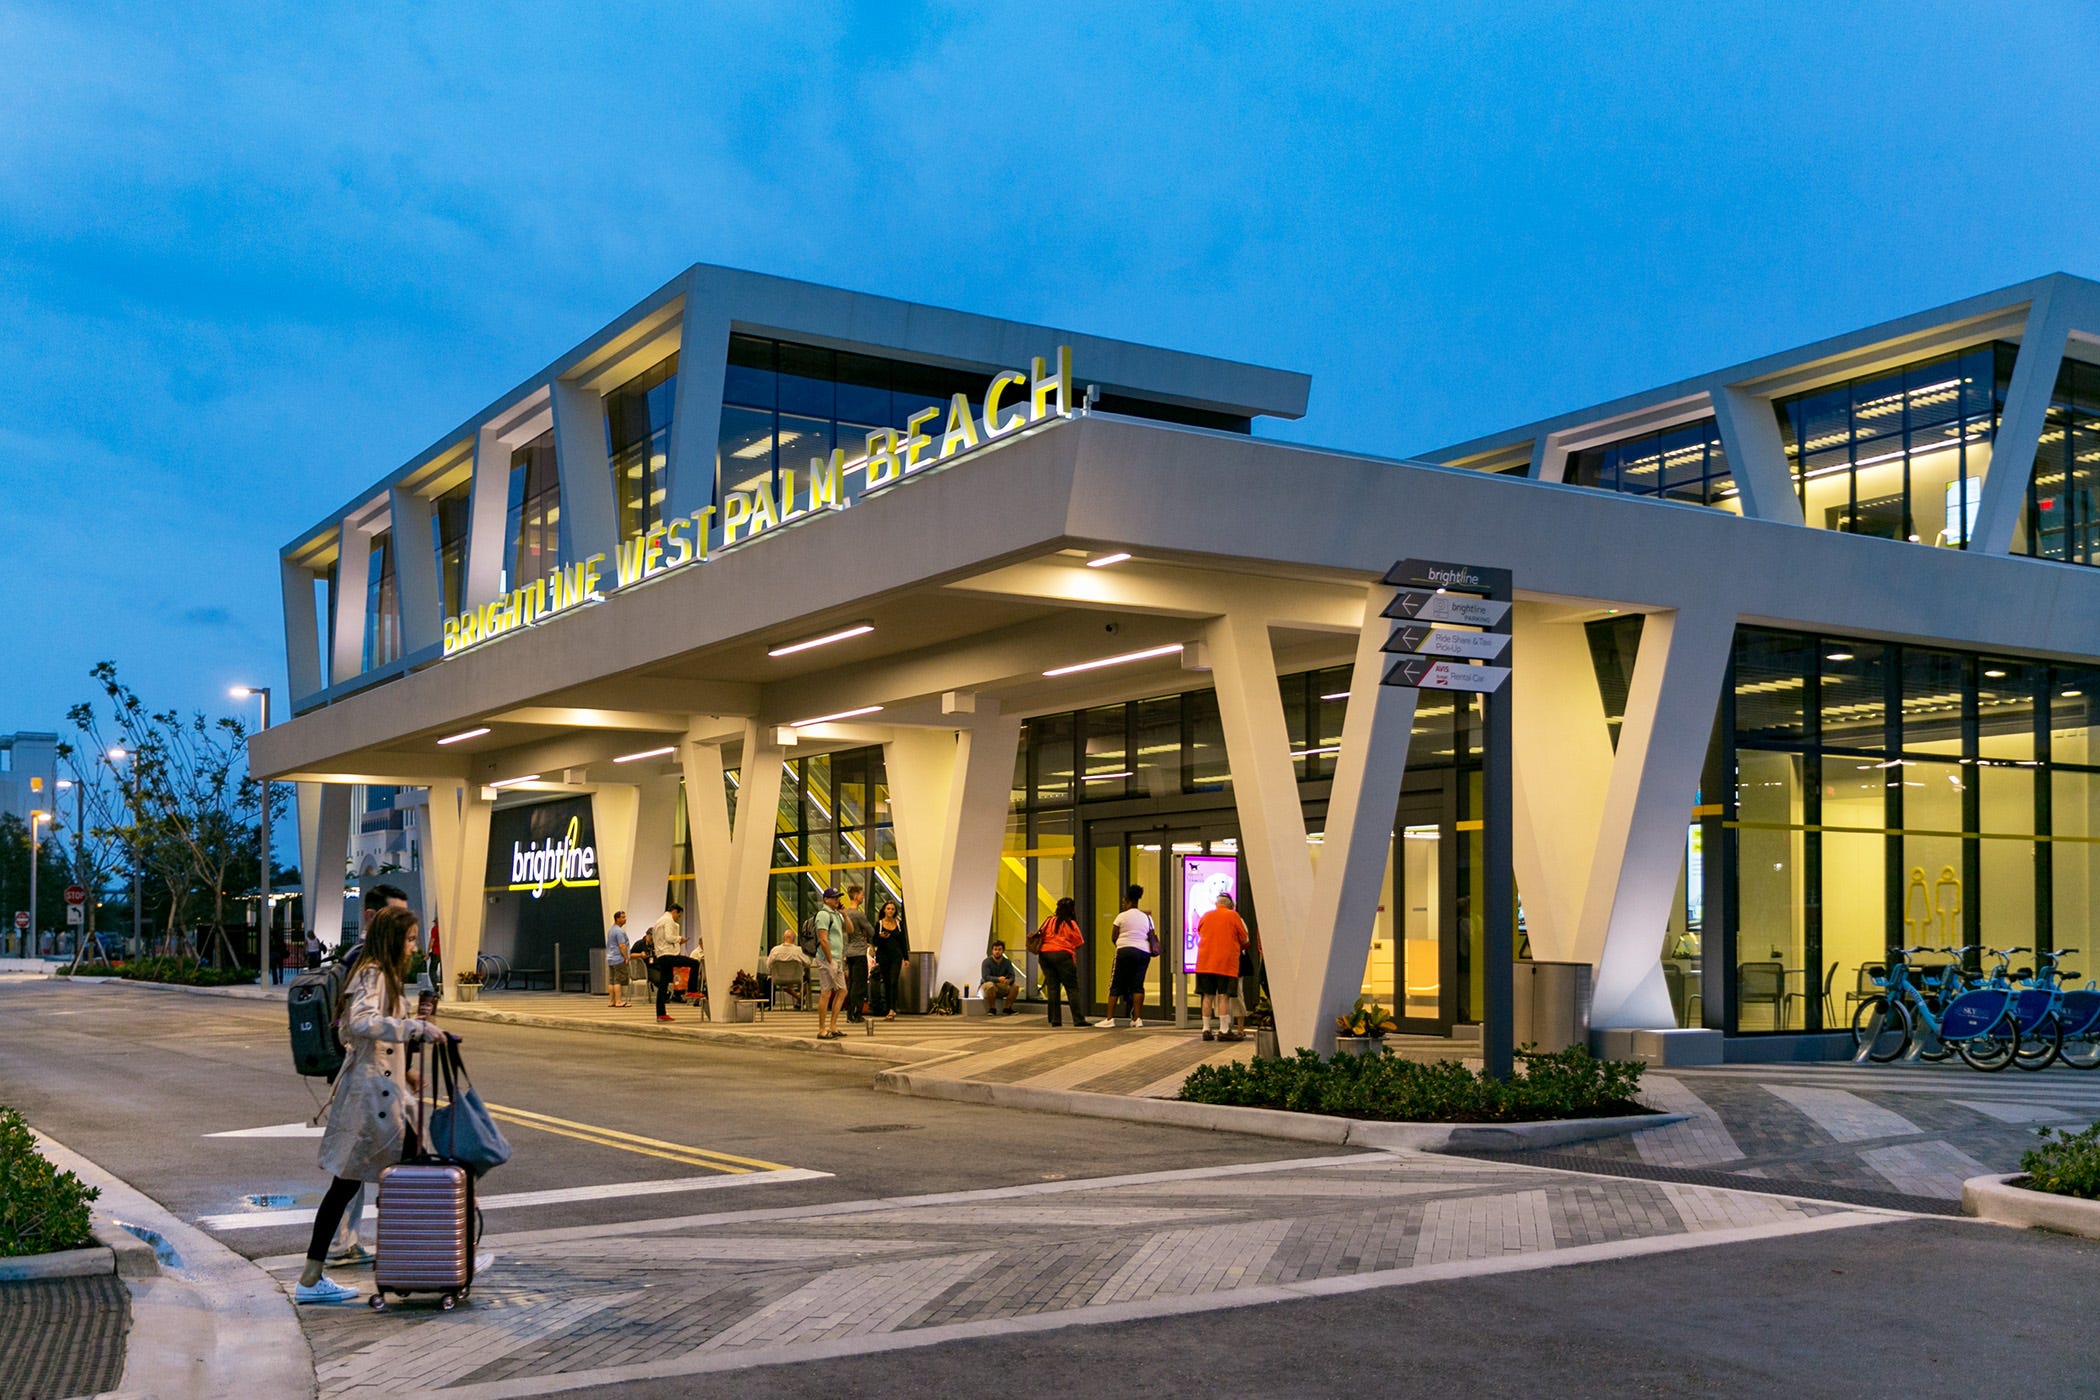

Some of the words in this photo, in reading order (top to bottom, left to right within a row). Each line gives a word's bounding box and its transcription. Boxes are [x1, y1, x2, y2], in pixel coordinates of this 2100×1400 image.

[443, 553, 606, 656] BRIGHTLINE
[615, 505, 716, 588] WEST
[723, 449, 844, 546] PALM
[865, 345, 1073, 490] BEACH
[1428, 567, 1479, 586] brightline
[1451, 672, 1471, 681] Rental
[511, 816, 595, 898] brightline
[65, 891, 85, 900] STOP
